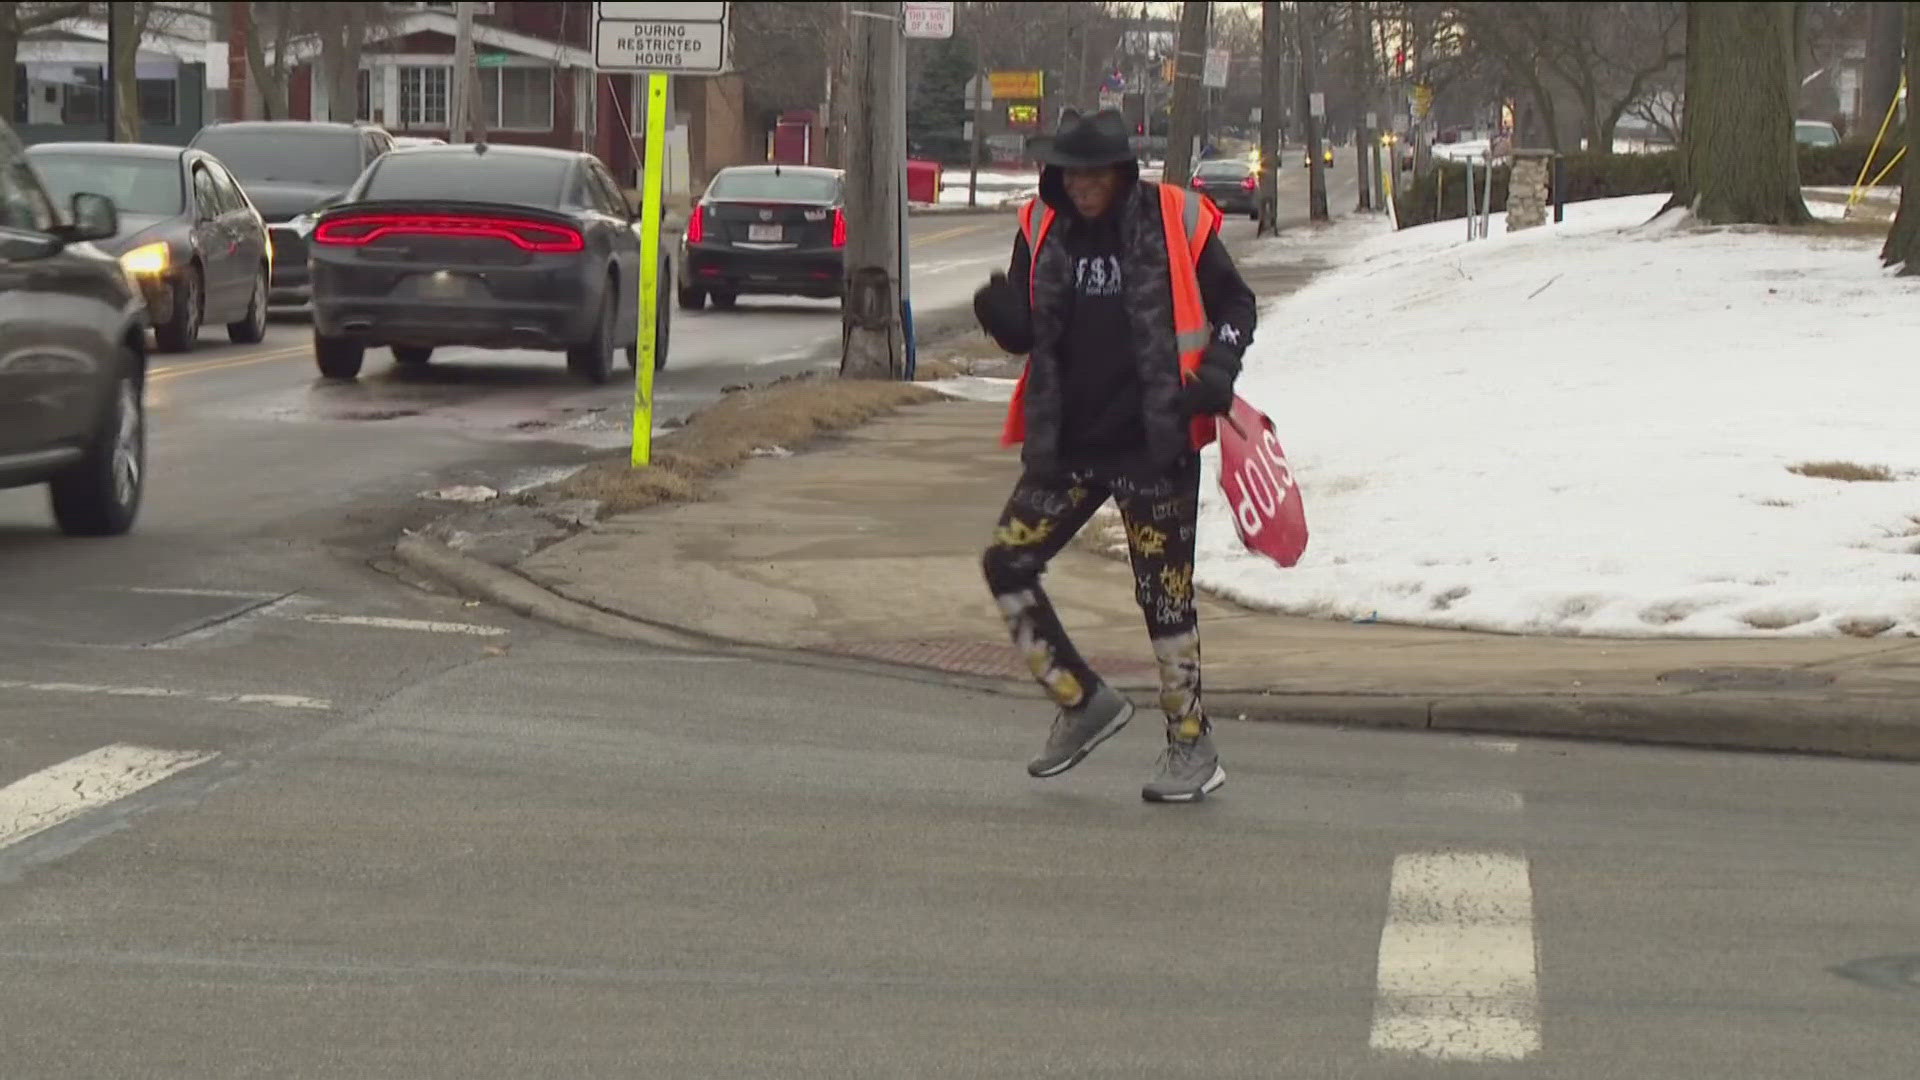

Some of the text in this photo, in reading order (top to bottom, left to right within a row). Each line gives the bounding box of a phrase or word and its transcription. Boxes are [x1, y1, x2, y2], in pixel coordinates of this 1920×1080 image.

[634, 25, 685, 36] DURING
[617, 38, 702, 51] RESTRICTED
[635, 53, 682, 65] HOURS
[1234, 429, 1293, 536] STOP
